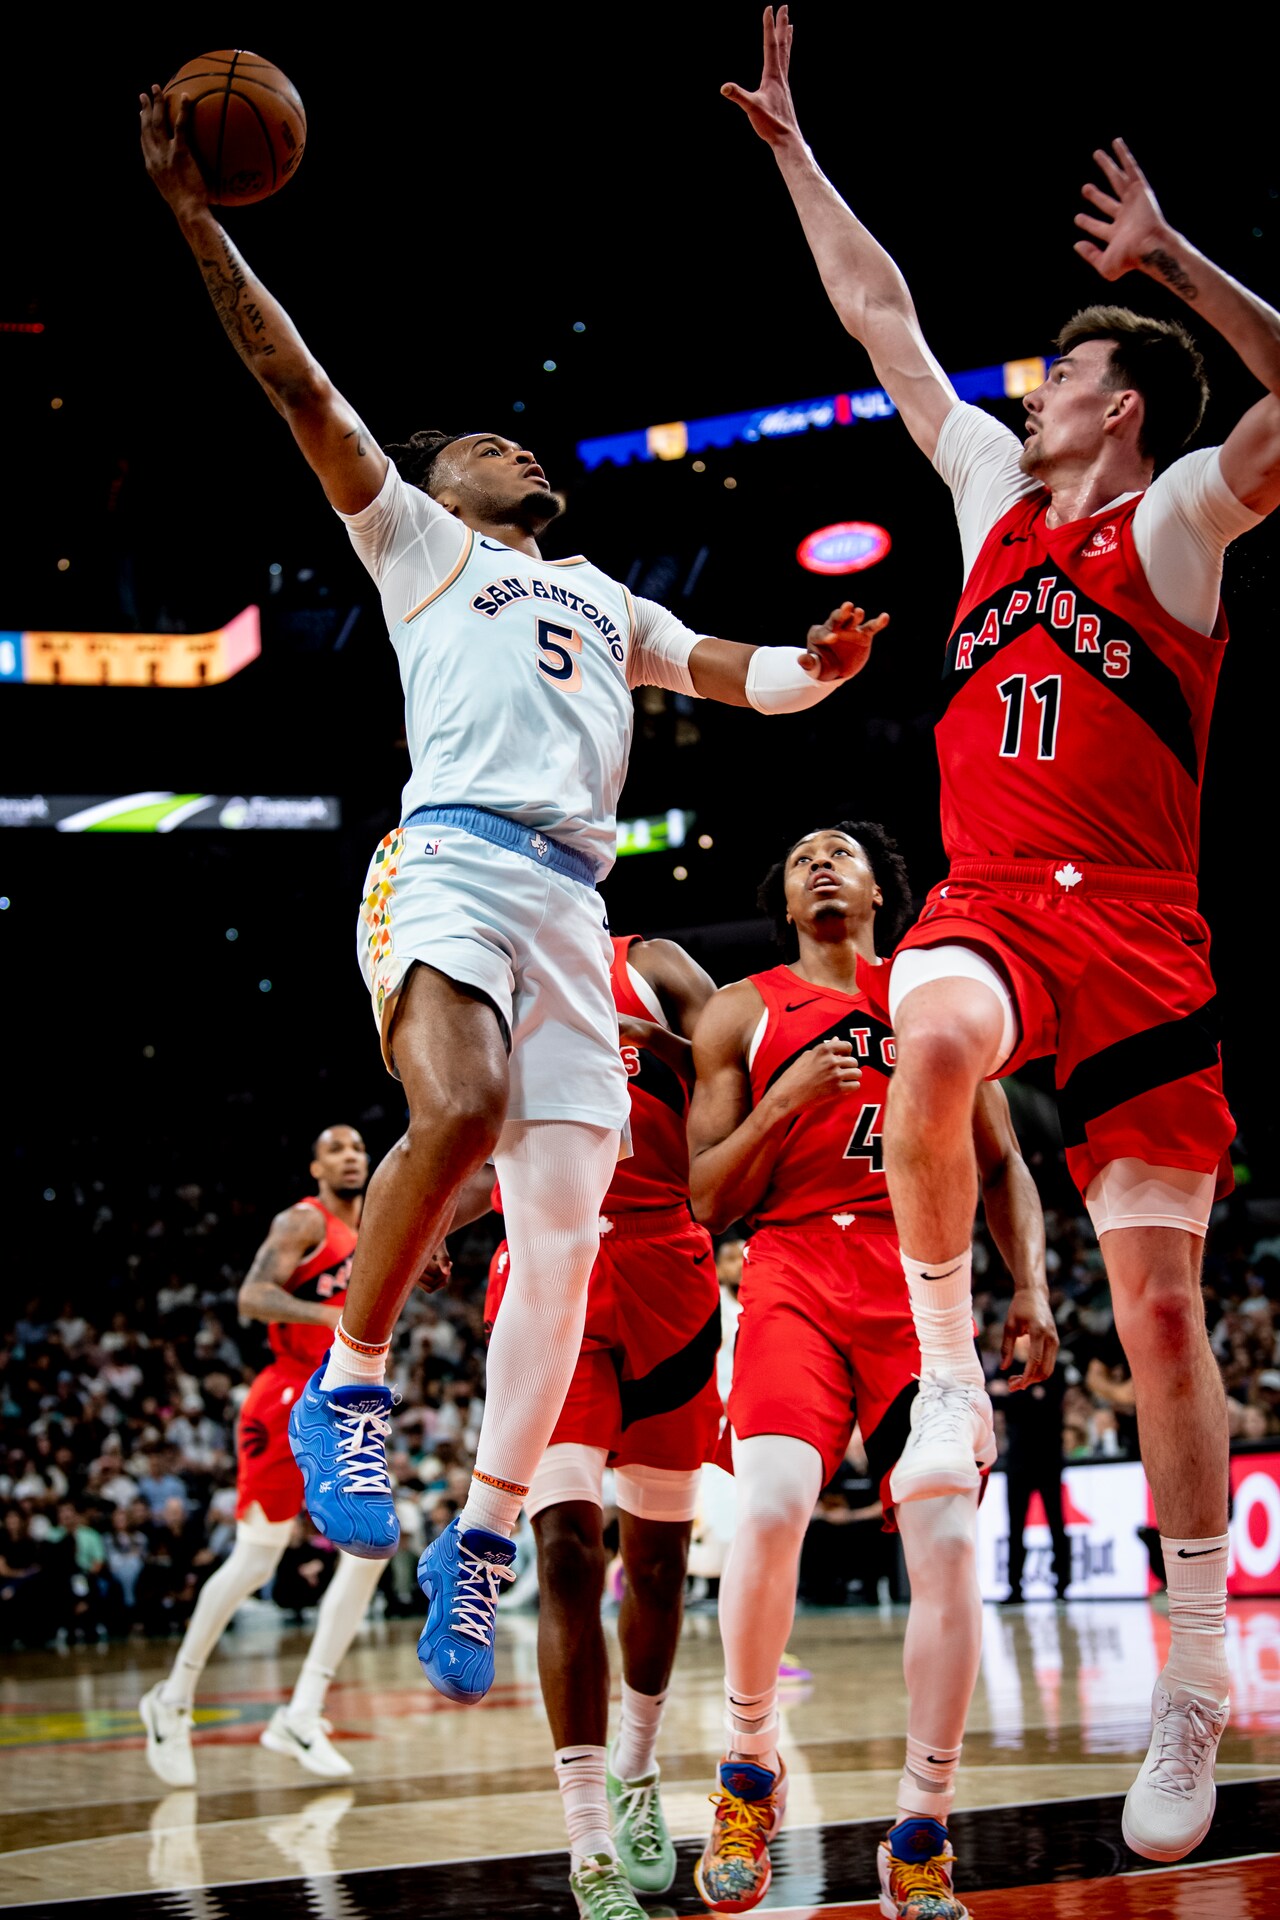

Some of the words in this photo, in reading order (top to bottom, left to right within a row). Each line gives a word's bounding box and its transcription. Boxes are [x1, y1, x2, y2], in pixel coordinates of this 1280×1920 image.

[1081, 549, 1101, 557] Sun
[1102, 541, 1118, 554] Life
[472, 577, 530, 618] SAN
[531, 578, 625, 664] ANTONIO
[536, 617, 578, 686] 5
[955, 577, 1131, 679] RAPTORS
[996, 674, 1062, 760] 11
[619, 1045, 641, 1077] S
[849, 1027, 896, 1067] TO
[842, 1104, 884, 1173] 4
